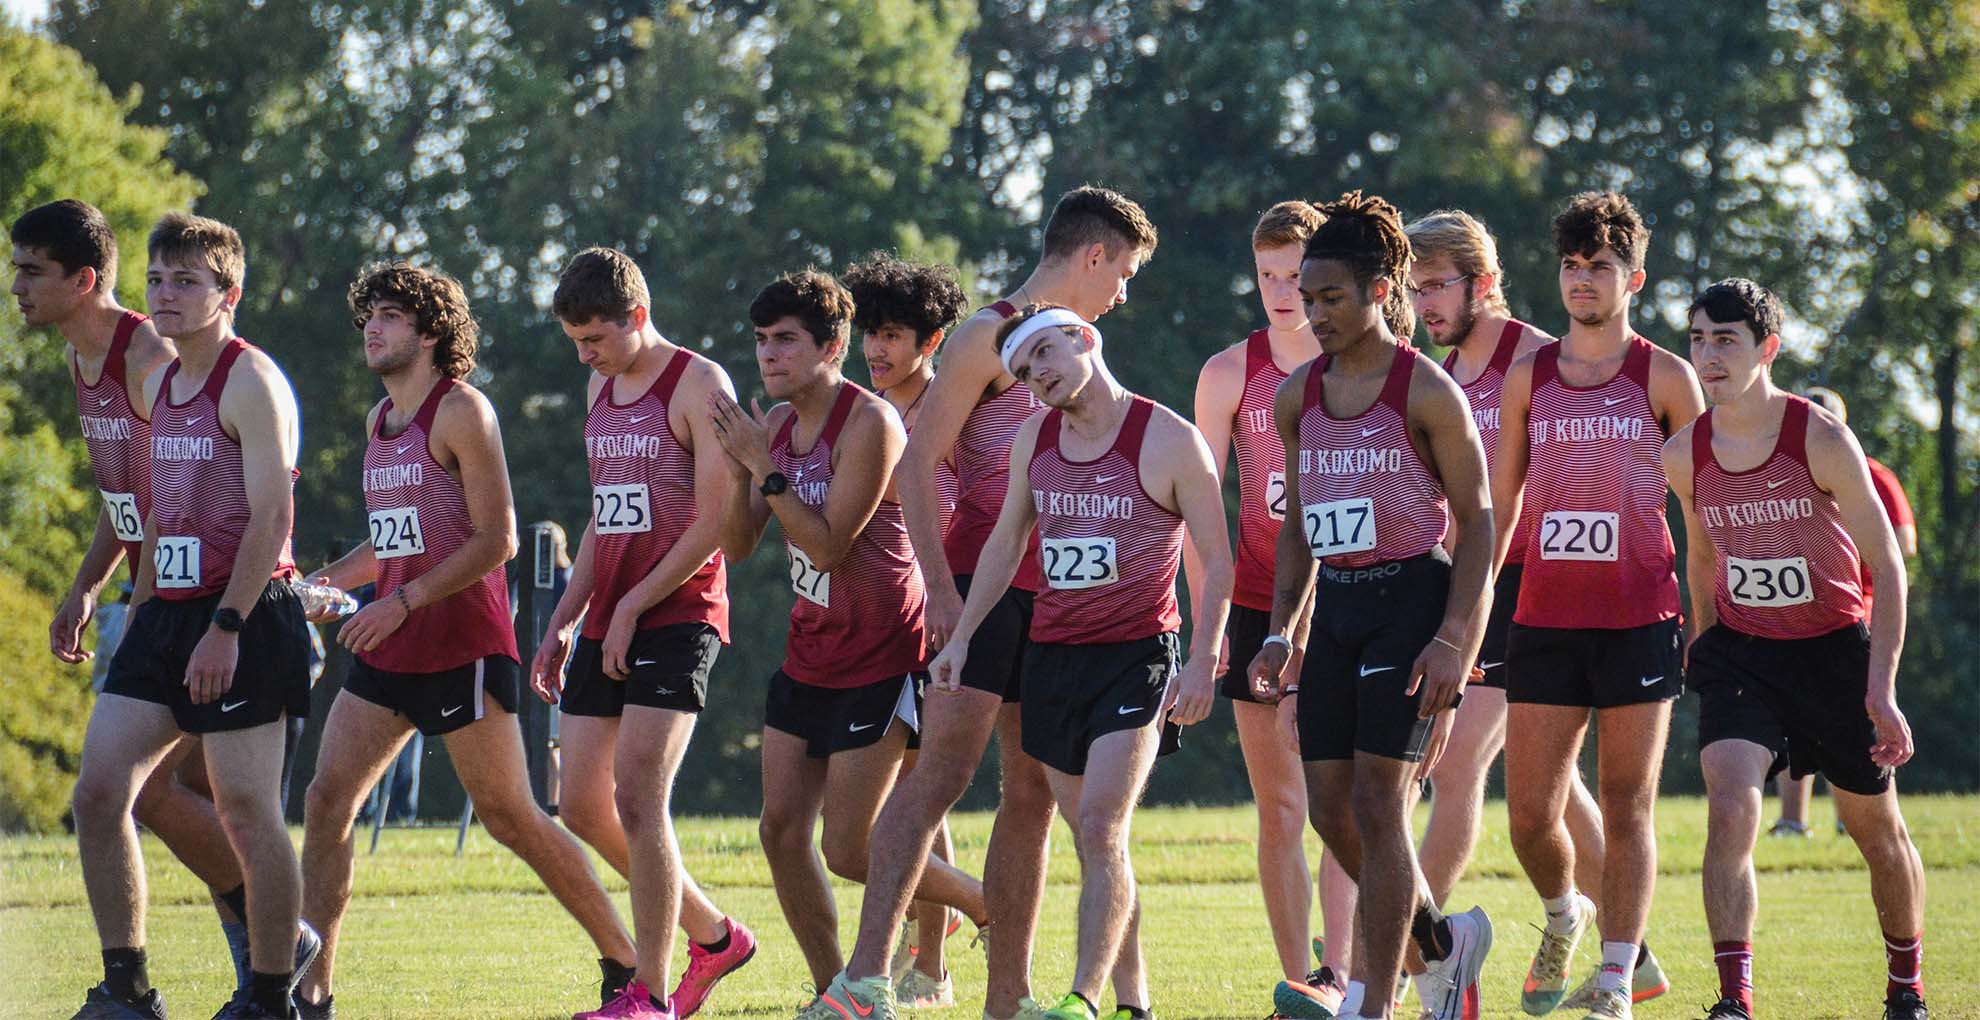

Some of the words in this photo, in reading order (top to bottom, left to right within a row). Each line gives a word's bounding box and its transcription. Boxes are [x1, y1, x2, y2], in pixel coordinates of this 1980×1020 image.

[1249, 409, 1268, 433] IU
[1534, 420, 1548, 445] IU
[1555, 416, 1642, 442] KOKOMO
[157, 436, 213, 460] KOKOMO
[597, 434, 660, 459] KOKOMO
[371, 463, 423, 490] KOKOMO
[1318, 449, 1401, 475] KOKOMO
[595, 492, 644, 527] 225
[1050, 491, 1133, 520] KOKOMO
[1704, 506, 1724, 528] IU
[1727, 498, 1814, 528] KOKOMO
[370, 514, 417, 552] 224
[1306, 506, 1369, 549] 217
[1543, 518, 1614, 555] 220
[790, 552, 825, 597] 27
[1045, 545, 1111, 581] 223
[1354, 562, 1401, 583] PRO
[1730, 564, 1805, 600] 230
